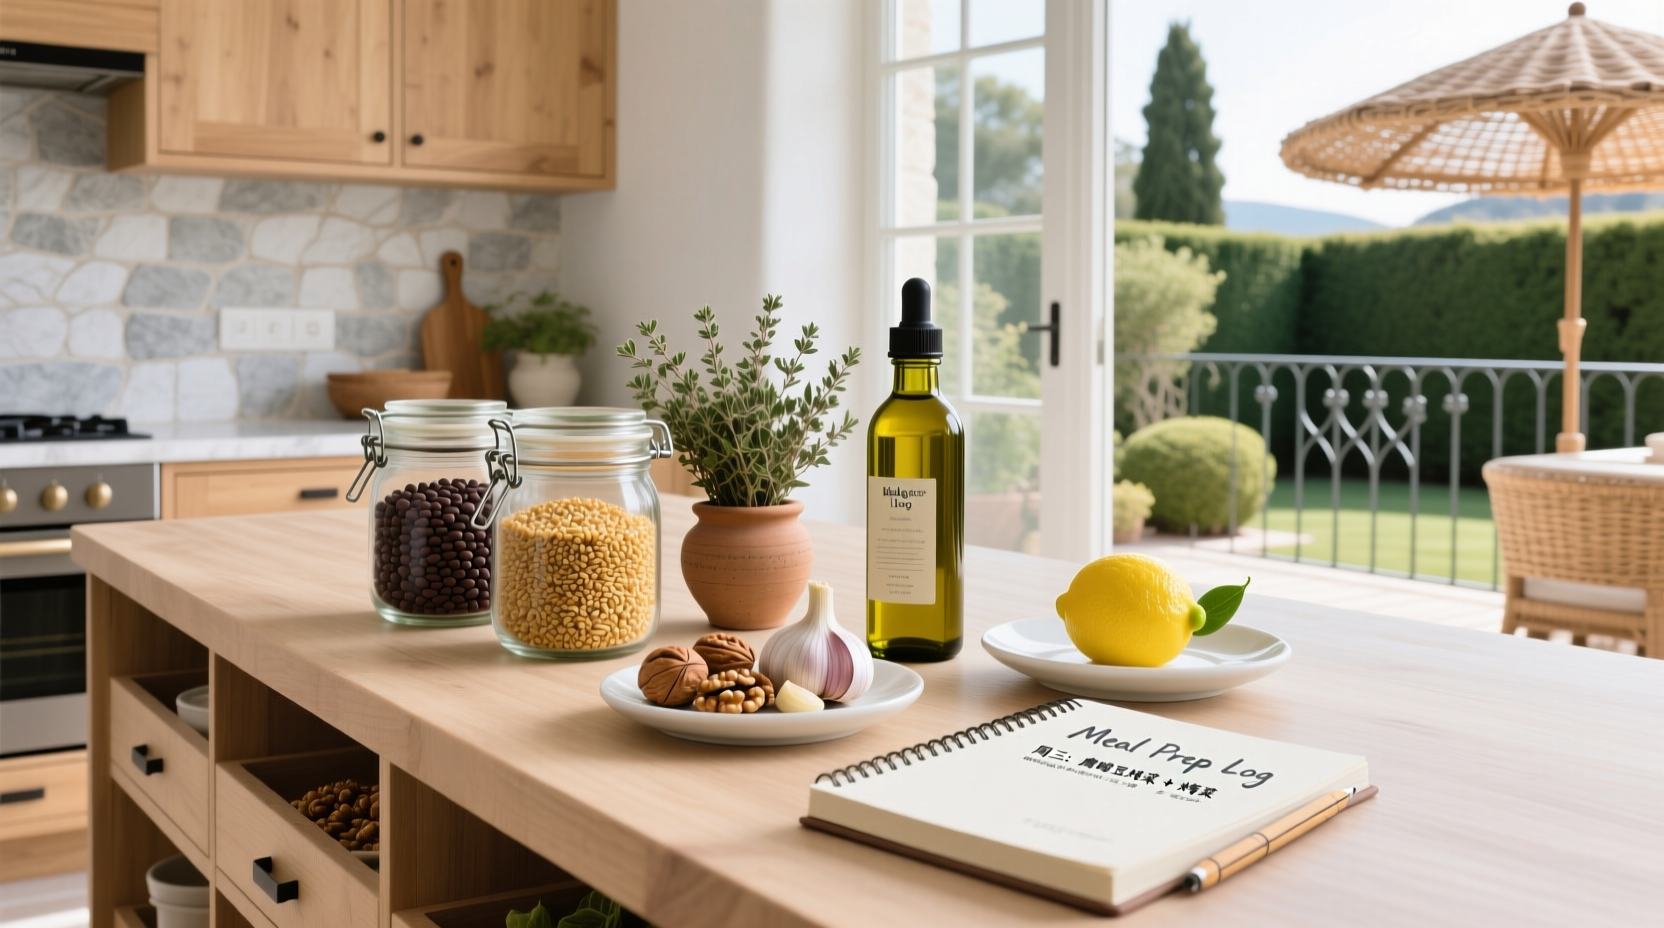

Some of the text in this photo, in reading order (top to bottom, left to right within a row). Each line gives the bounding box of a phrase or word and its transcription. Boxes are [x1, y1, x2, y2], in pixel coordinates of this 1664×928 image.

[1067, 726, 1152, 753] Meal
[1148, 742, 1213, 774] Prep
[1220, 758, 1275, 789] Log
